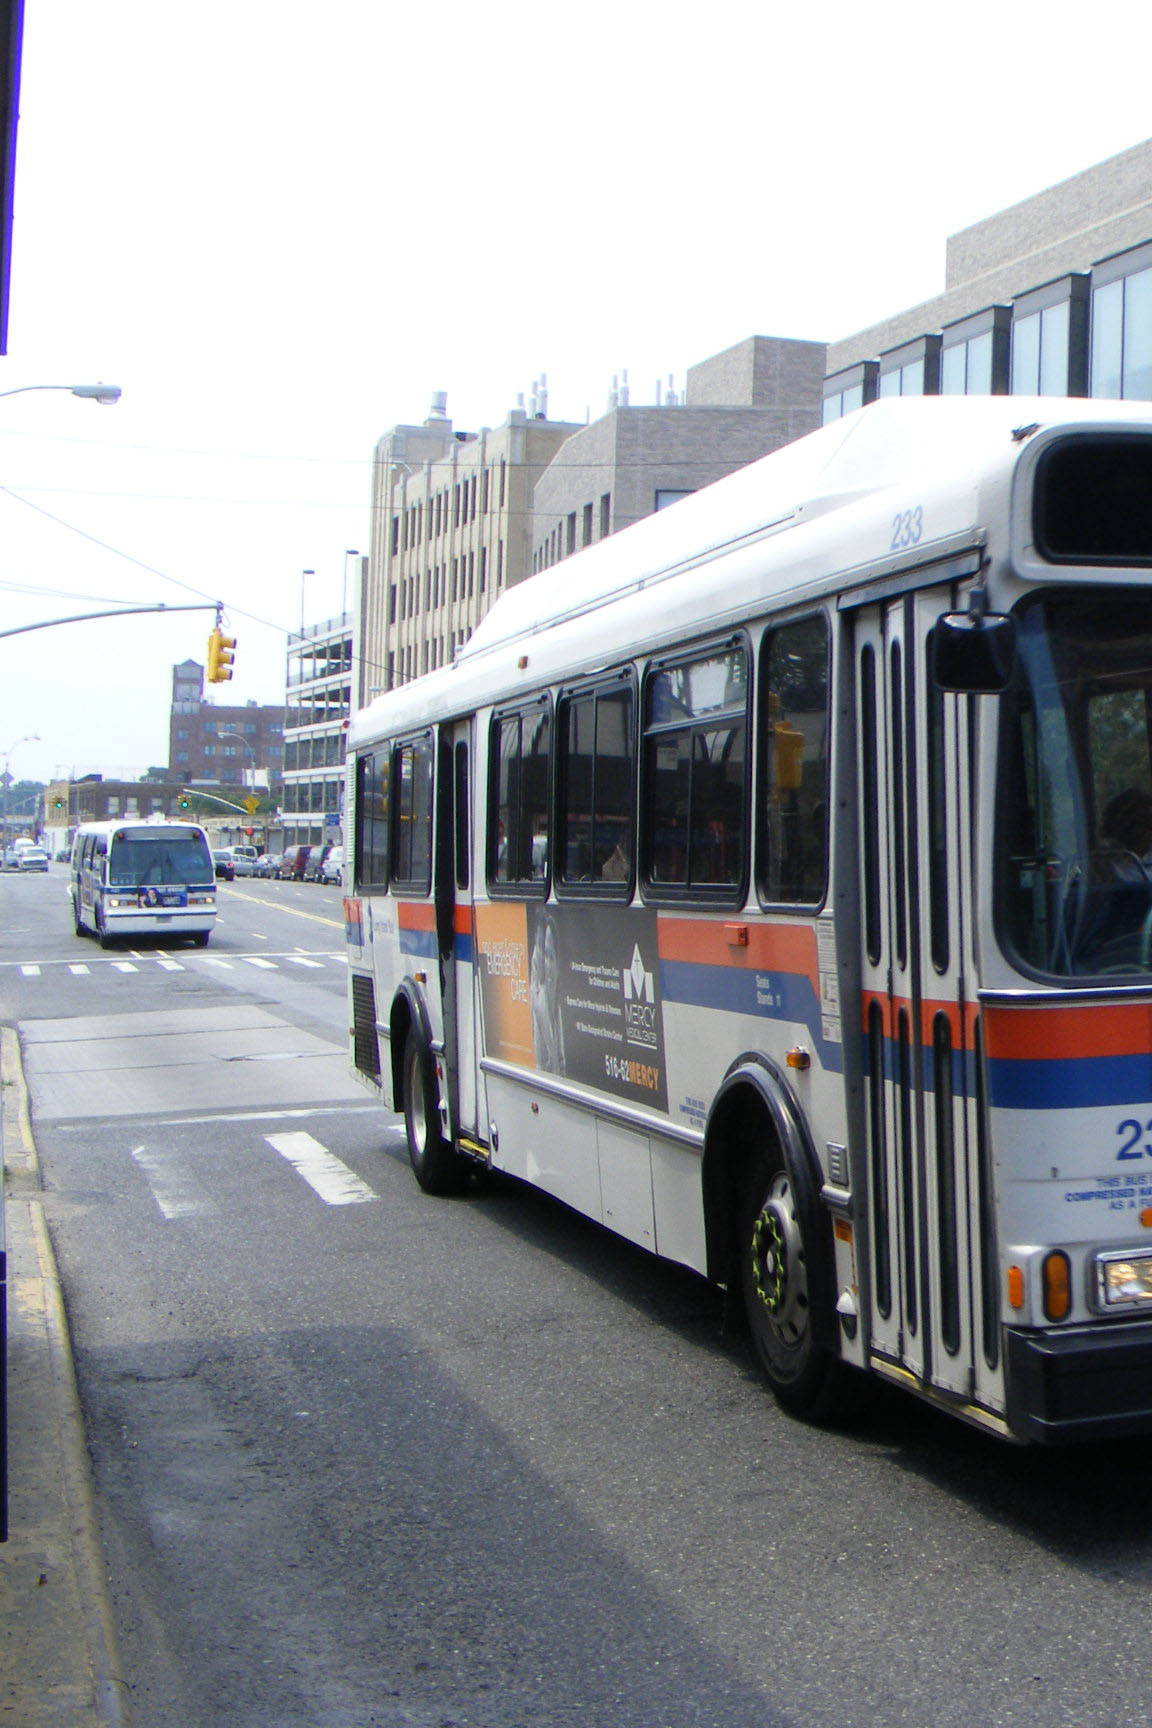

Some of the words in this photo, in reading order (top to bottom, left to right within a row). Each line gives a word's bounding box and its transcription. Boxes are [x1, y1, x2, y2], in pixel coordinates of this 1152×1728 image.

[889, 504, 923, 551] 233
[624, 1002, 656, 1028] MERCY
[1096, 1176, 1121, 1188] THIS
[1124, 1174, 1148, 1187] BUS
[1065, 1187, 1136, 1202] COMPRESSED
[1109, 1200, 1124, 1210] AS
[1129, 1199, 1136, 1209] A
